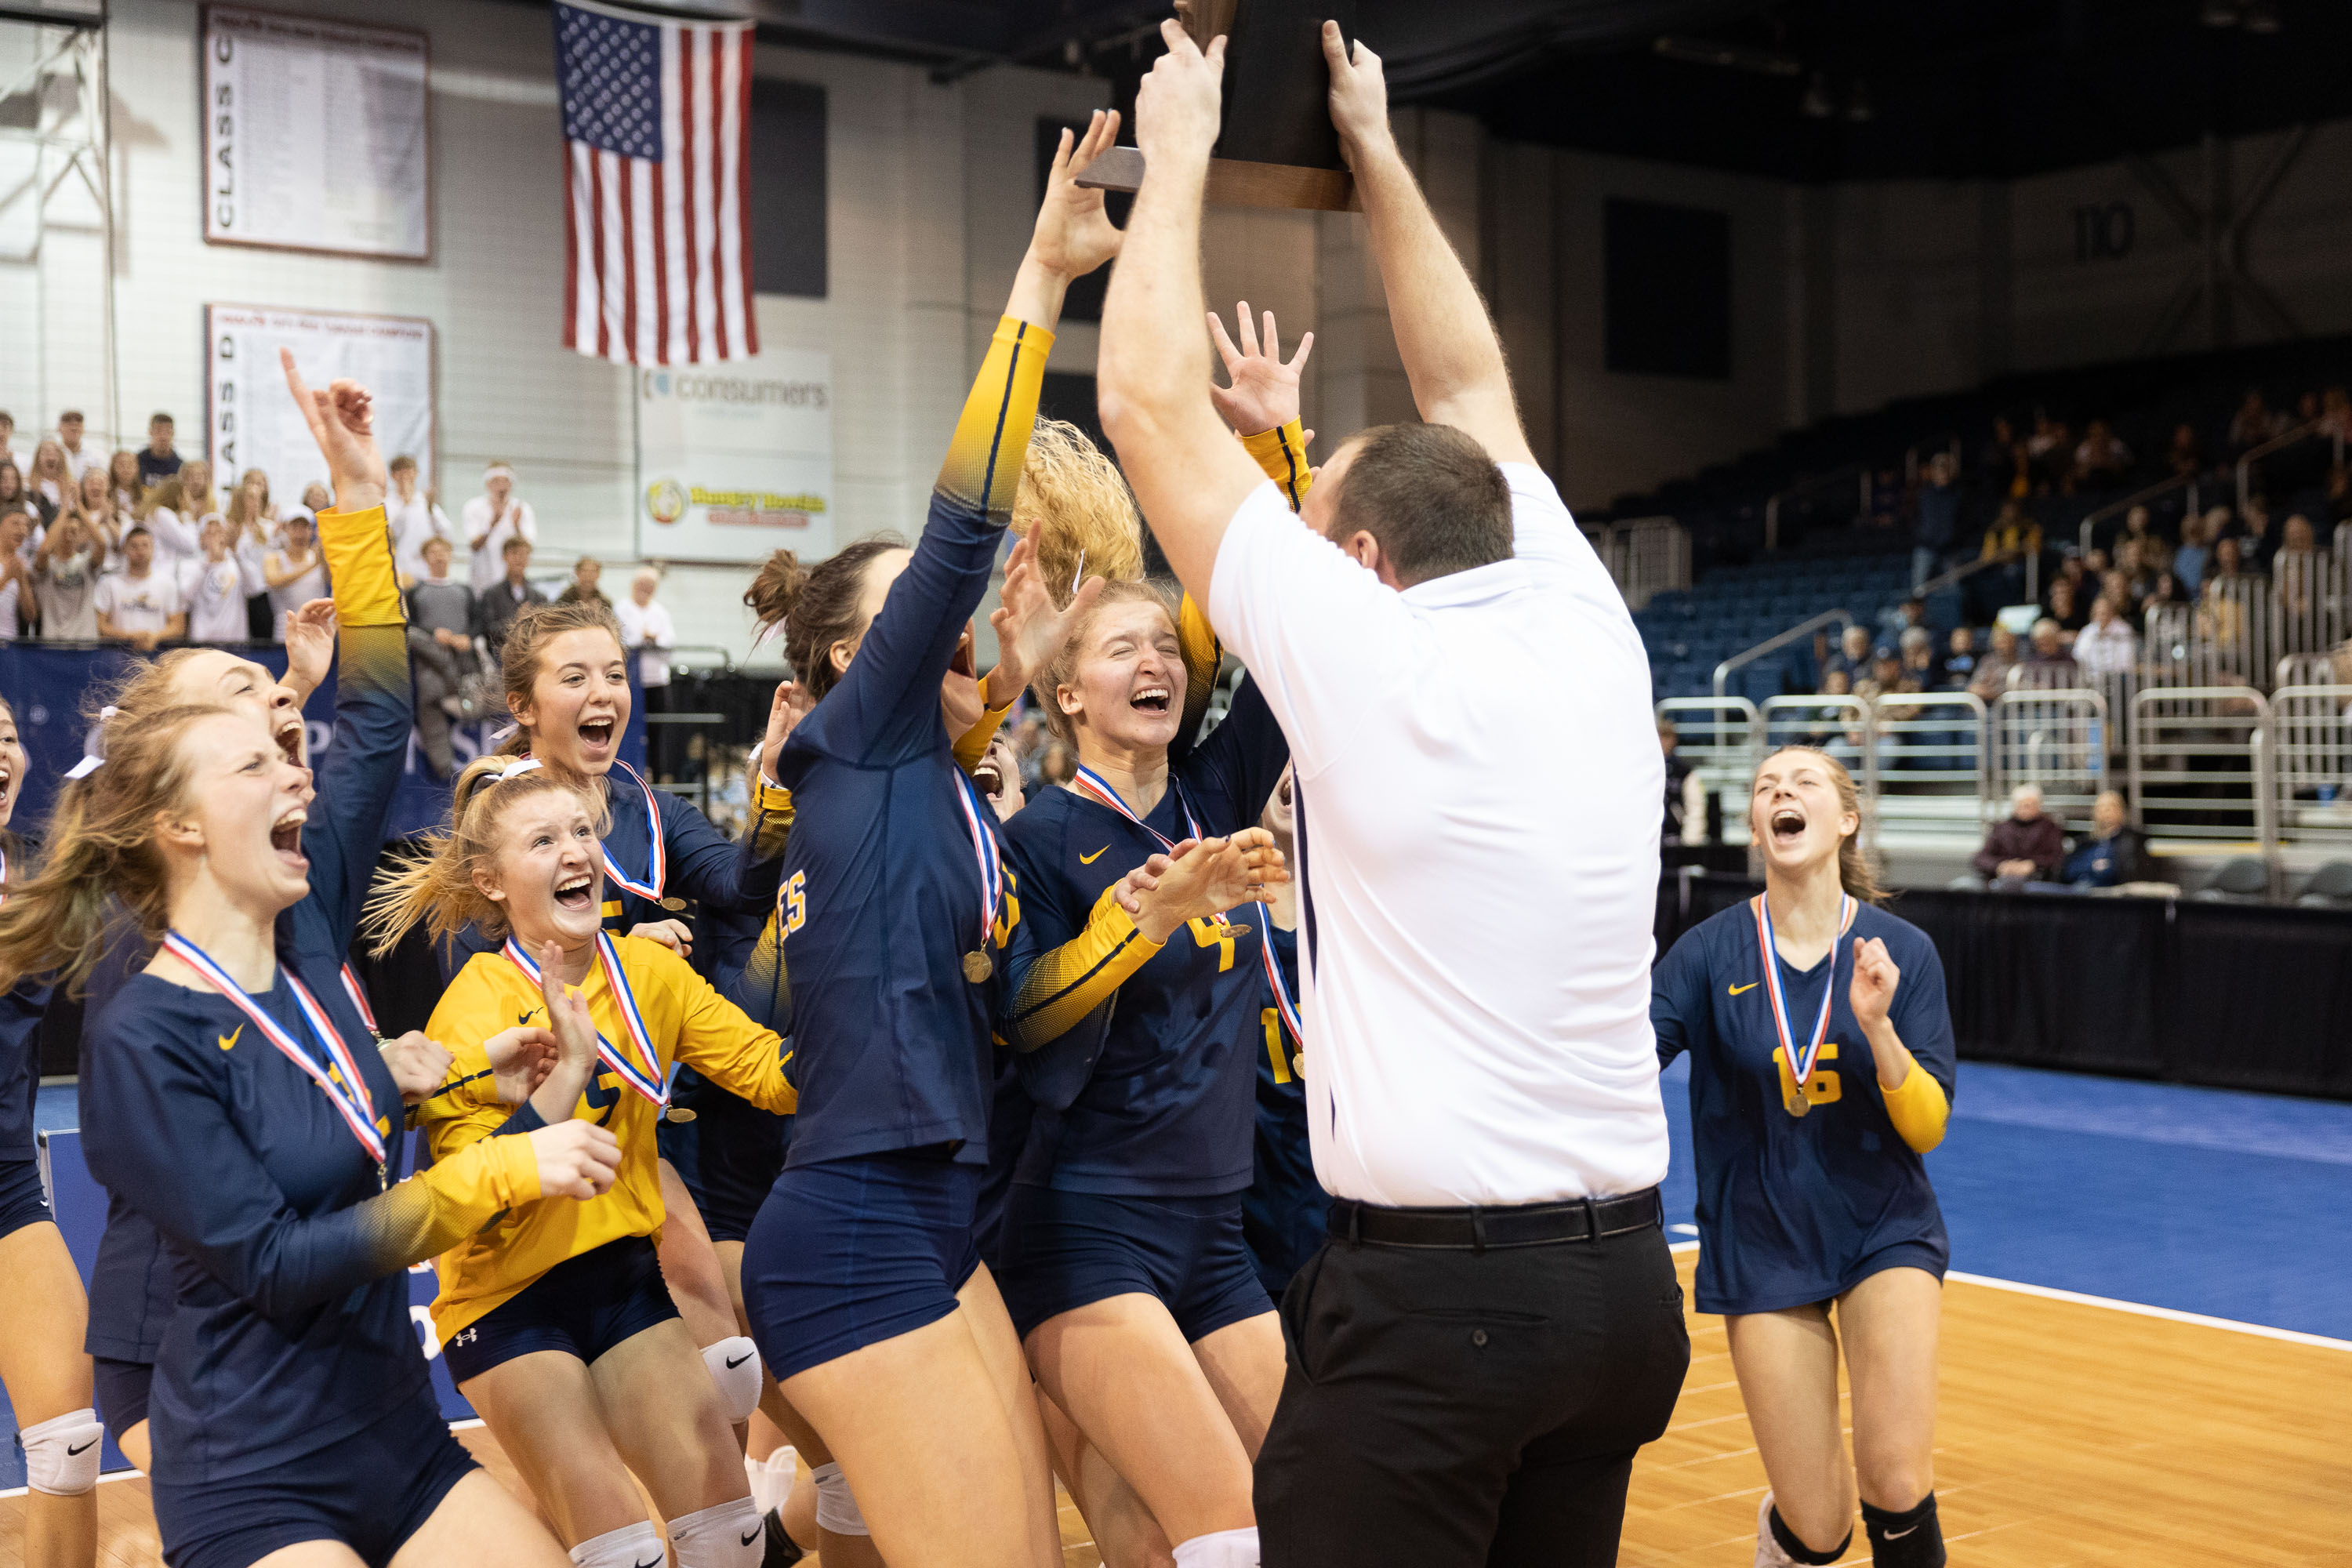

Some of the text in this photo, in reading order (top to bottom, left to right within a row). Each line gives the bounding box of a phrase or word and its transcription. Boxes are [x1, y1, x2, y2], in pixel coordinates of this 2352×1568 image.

[216, 36, 234, 228] CLASS C
[219, 334, 235, 492] LASS D
[1773, 1044, 1842, 1110] 16
